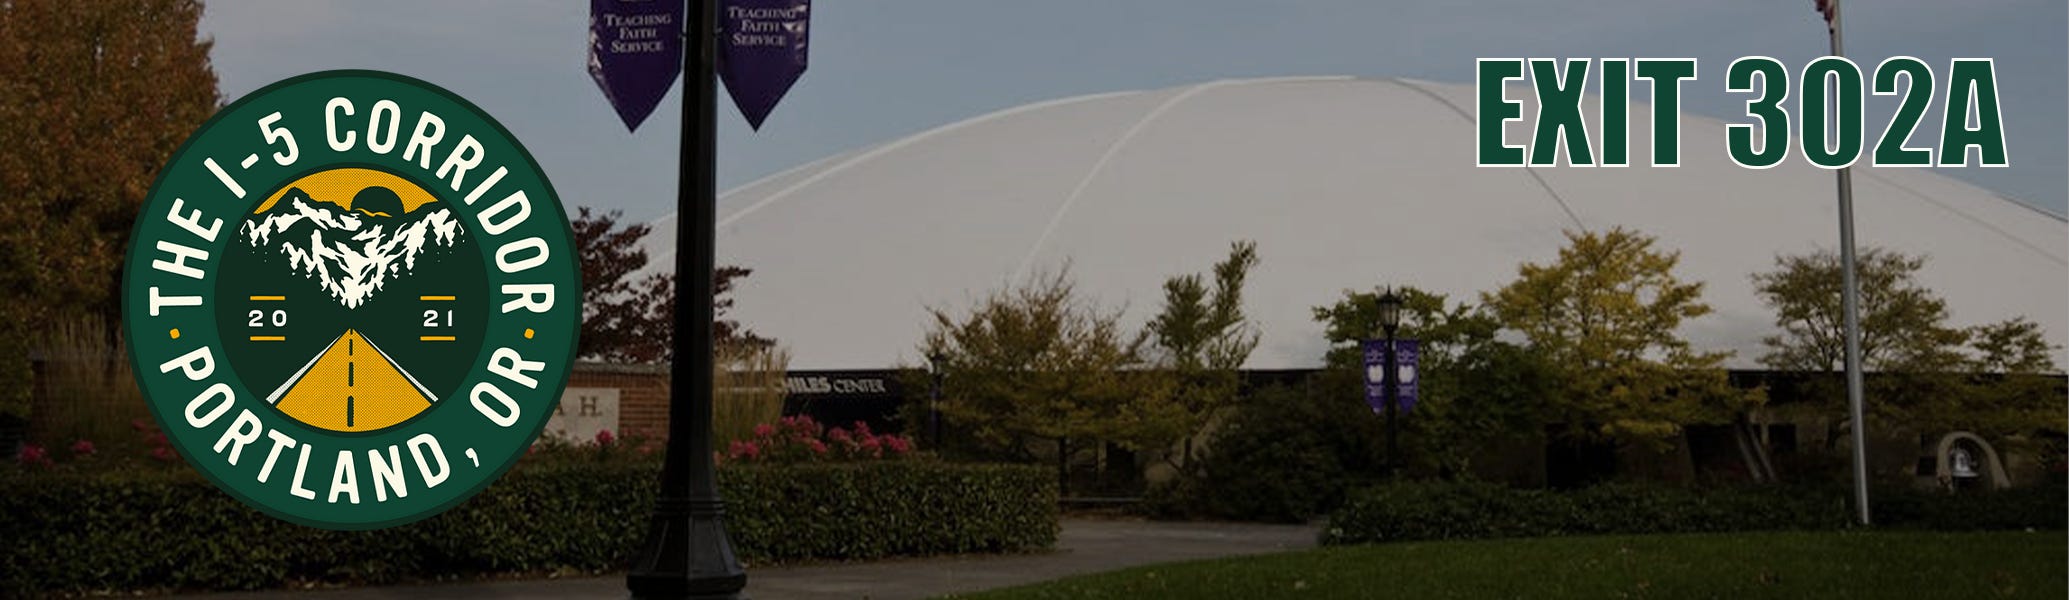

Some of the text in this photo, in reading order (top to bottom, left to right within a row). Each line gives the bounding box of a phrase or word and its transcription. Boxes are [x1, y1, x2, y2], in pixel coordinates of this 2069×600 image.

[728, 5, 797, 19] TEACHING
[602, 13, 672, 27] TEACHING
[741, 19, 780, 33] FAITH
[619, 27, 658, 40] FAITH
[731, 33, 787, 47] SERVICE
[610, 40, 665, 54] SERVICE
[833, 378, 887, 394] CENTER
